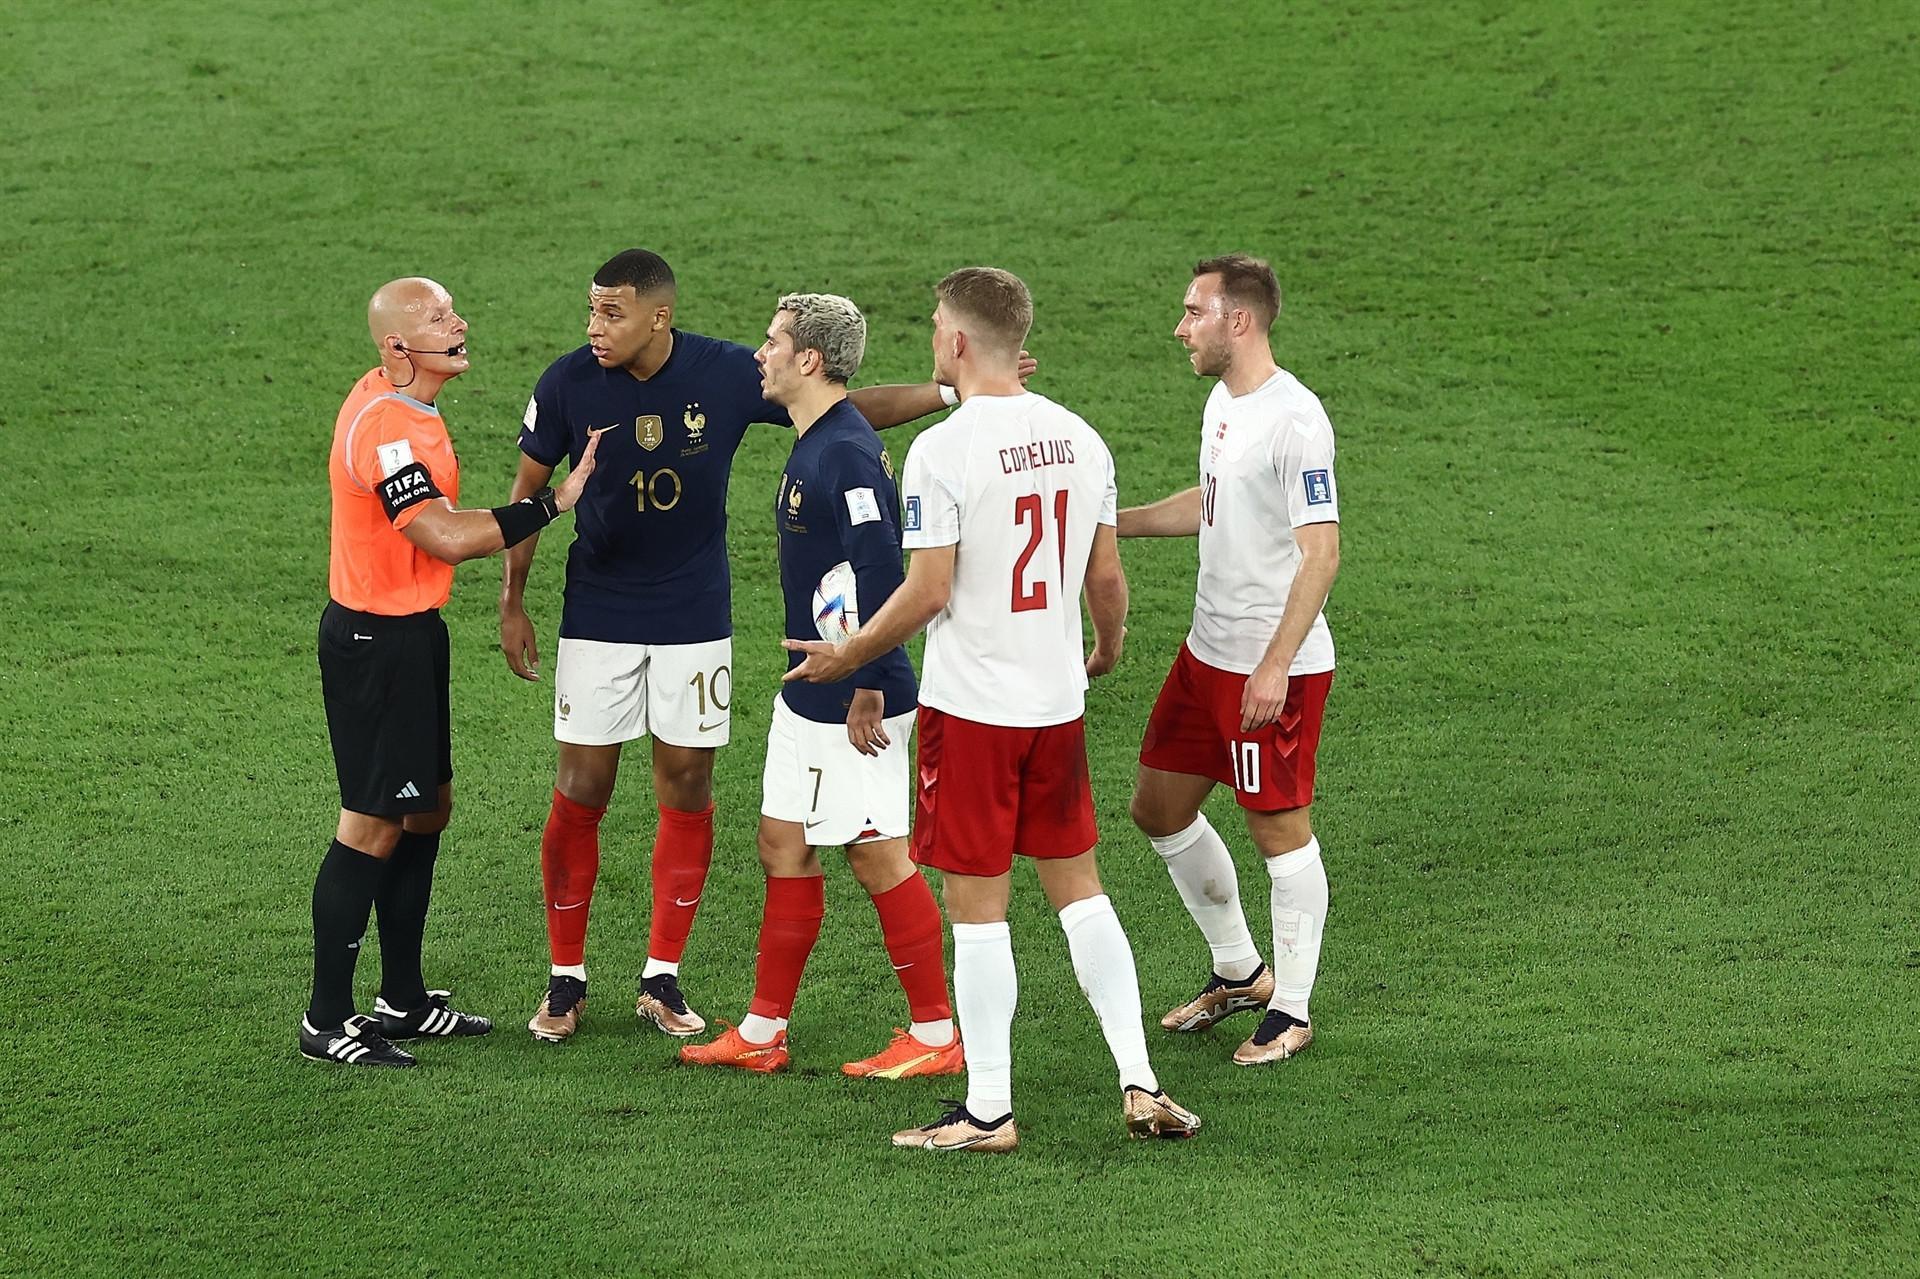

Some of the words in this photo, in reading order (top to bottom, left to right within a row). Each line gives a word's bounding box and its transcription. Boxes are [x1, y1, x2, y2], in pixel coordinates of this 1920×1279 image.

[385, 471, 426, 499] FIFA
[392, 492, 412, 507] TEAM
[629, 467, 682, 512] 10
[1011, 489, 1068, 613] 21
[690, 665, 731, 715] 10
[809, 766, 823, 812] 7
[1231, 740, 1260, 794] 10
